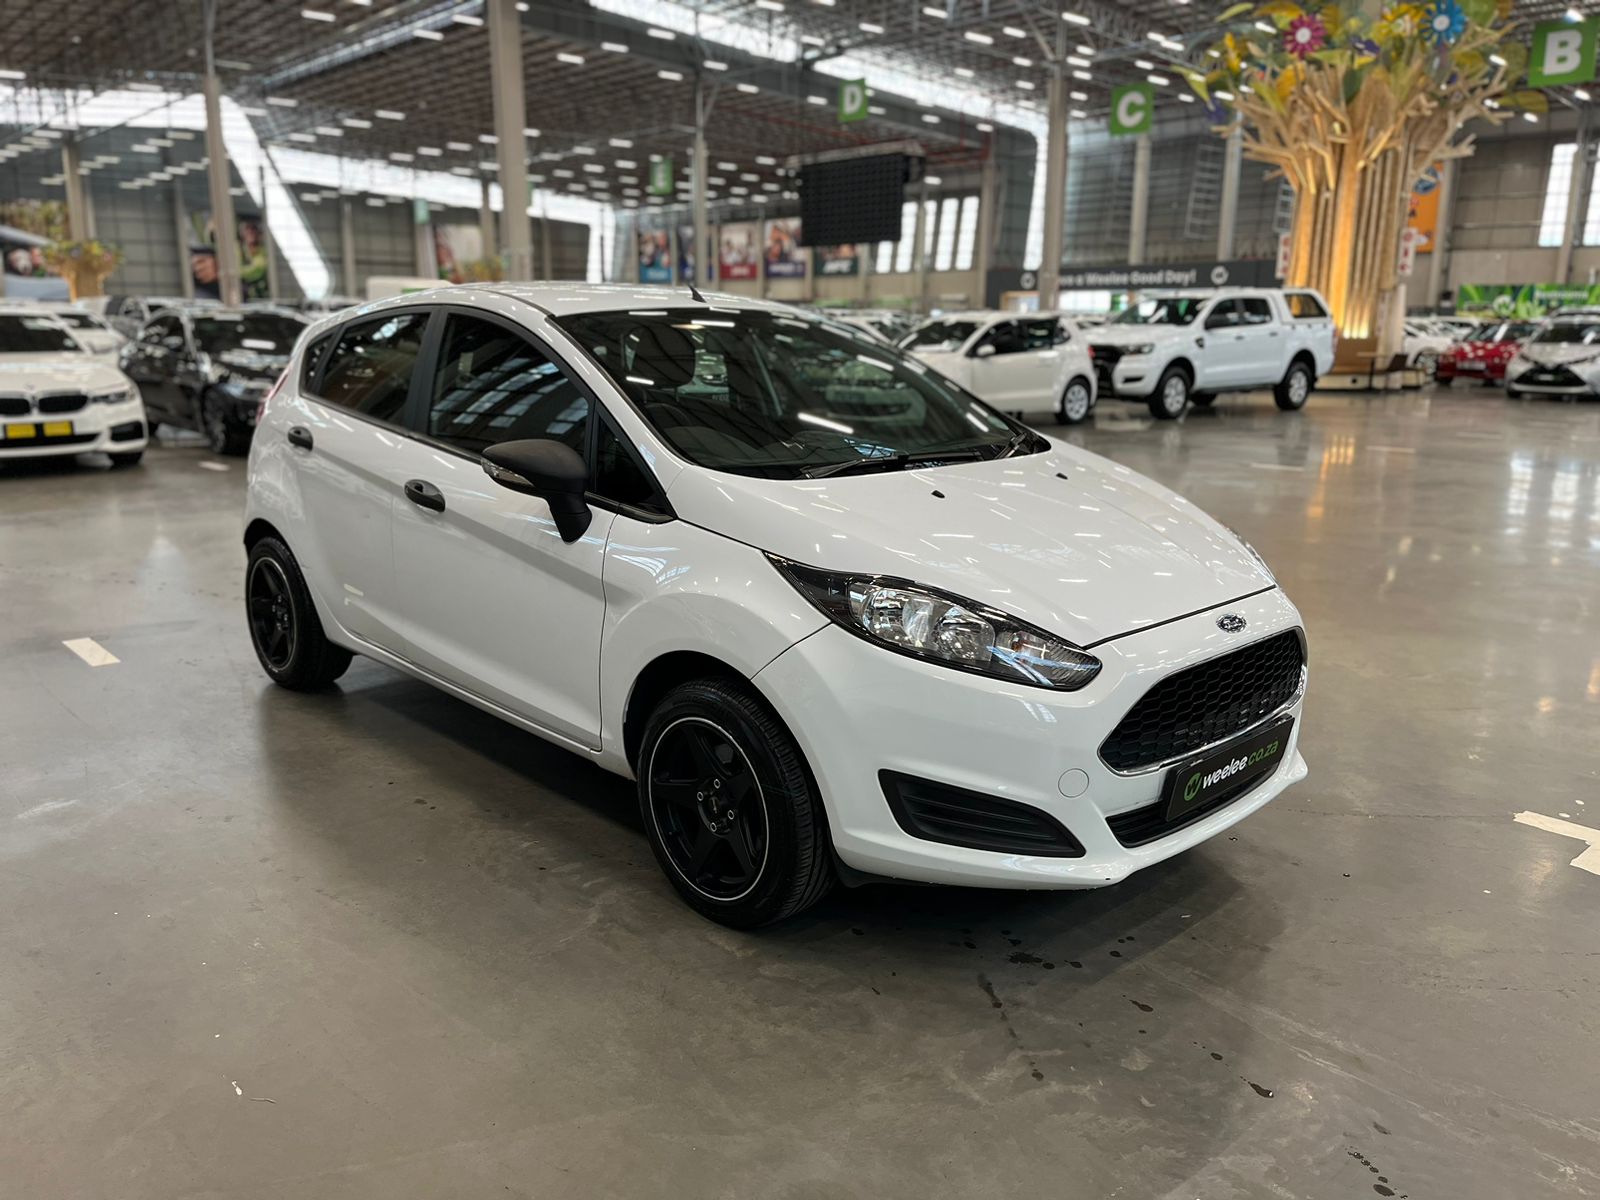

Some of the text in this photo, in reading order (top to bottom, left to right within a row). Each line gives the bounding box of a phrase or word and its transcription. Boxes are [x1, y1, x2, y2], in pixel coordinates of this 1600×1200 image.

[1543, 29, 1582, 76] B
[844, 85, 863, 114] D
[1117, 91, 1146, 127] C
[1131, 270, 1163, 285] Good
